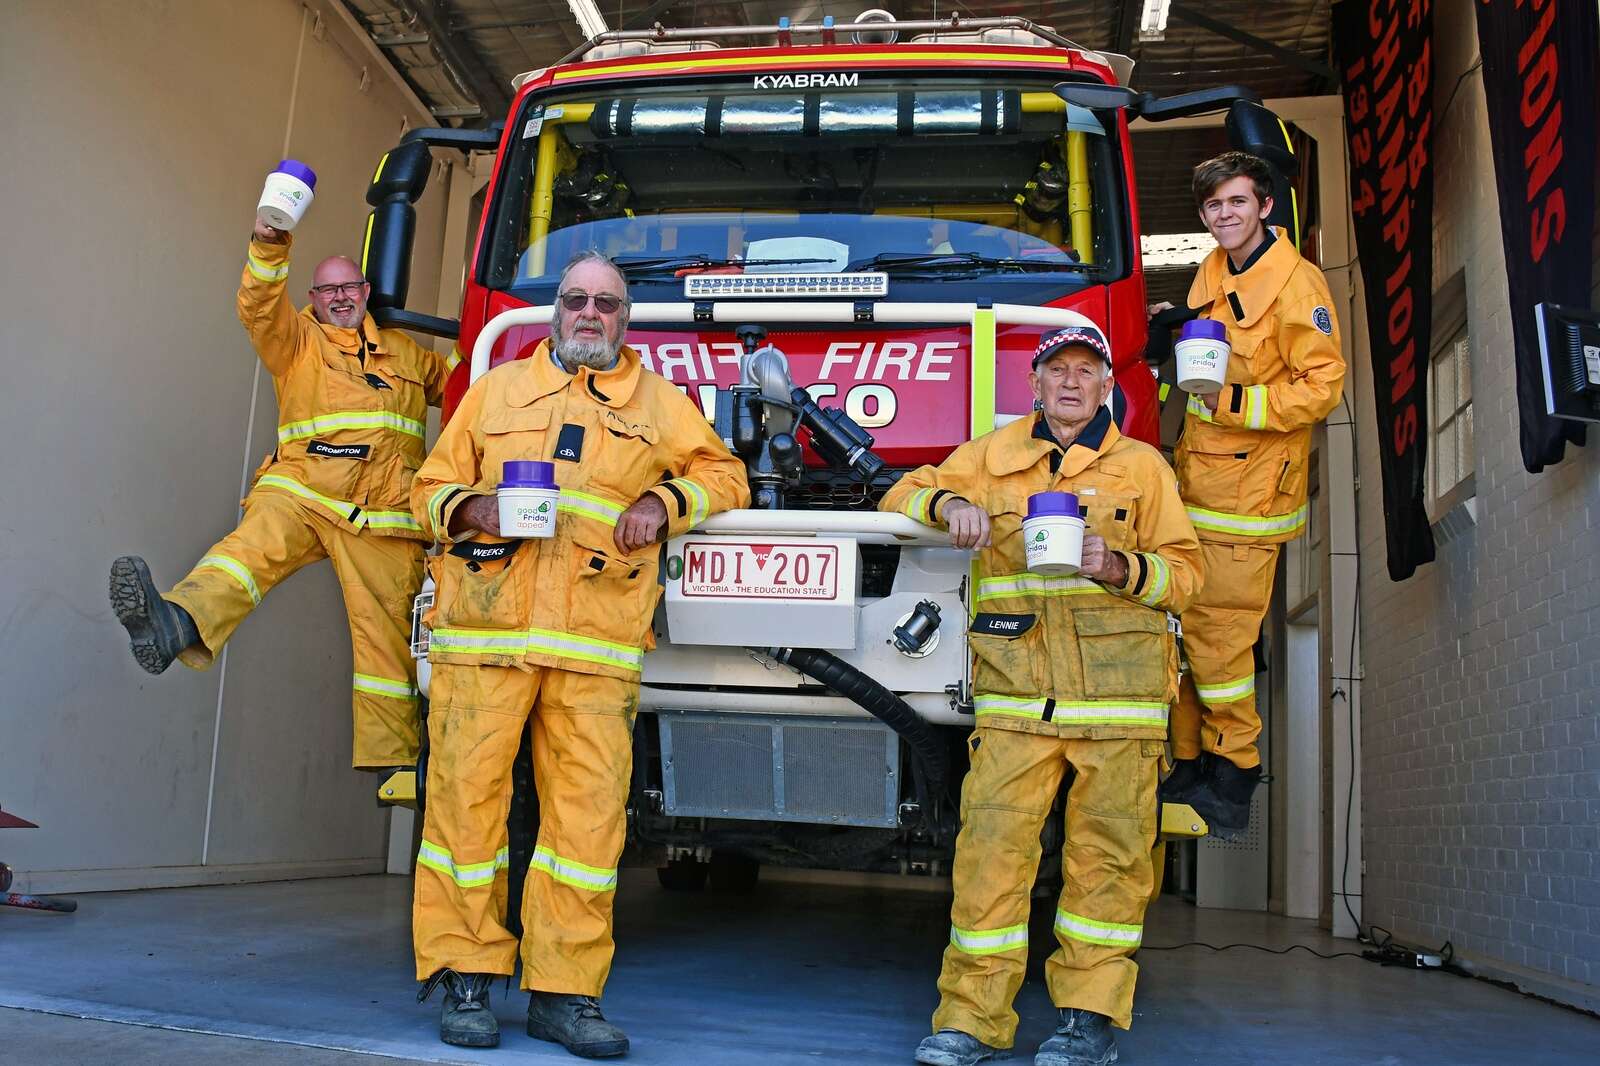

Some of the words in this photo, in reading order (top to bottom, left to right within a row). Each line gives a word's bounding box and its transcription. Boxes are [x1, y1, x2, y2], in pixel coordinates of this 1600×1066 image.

[753, 73, 859, 90] KYABRAM
[1347, 56, 1376, 217] 1924
[1513, 0, 1567, 264] IONS
[818, 342, 960, 381] FIRE
[316, 445, 361, 454] CROMPTON
[472, 548, 505, 557] WEEKS
[688, 551, 744, 583] MDI
[773, 552, 831, 586] 207
[692, 585, 729, 593] VICTORIA
[754, 586, 800, 595] EDUCATION
[803, 587, 827, 595] STATE
[989, 620, 1019, 630] LENNIE
